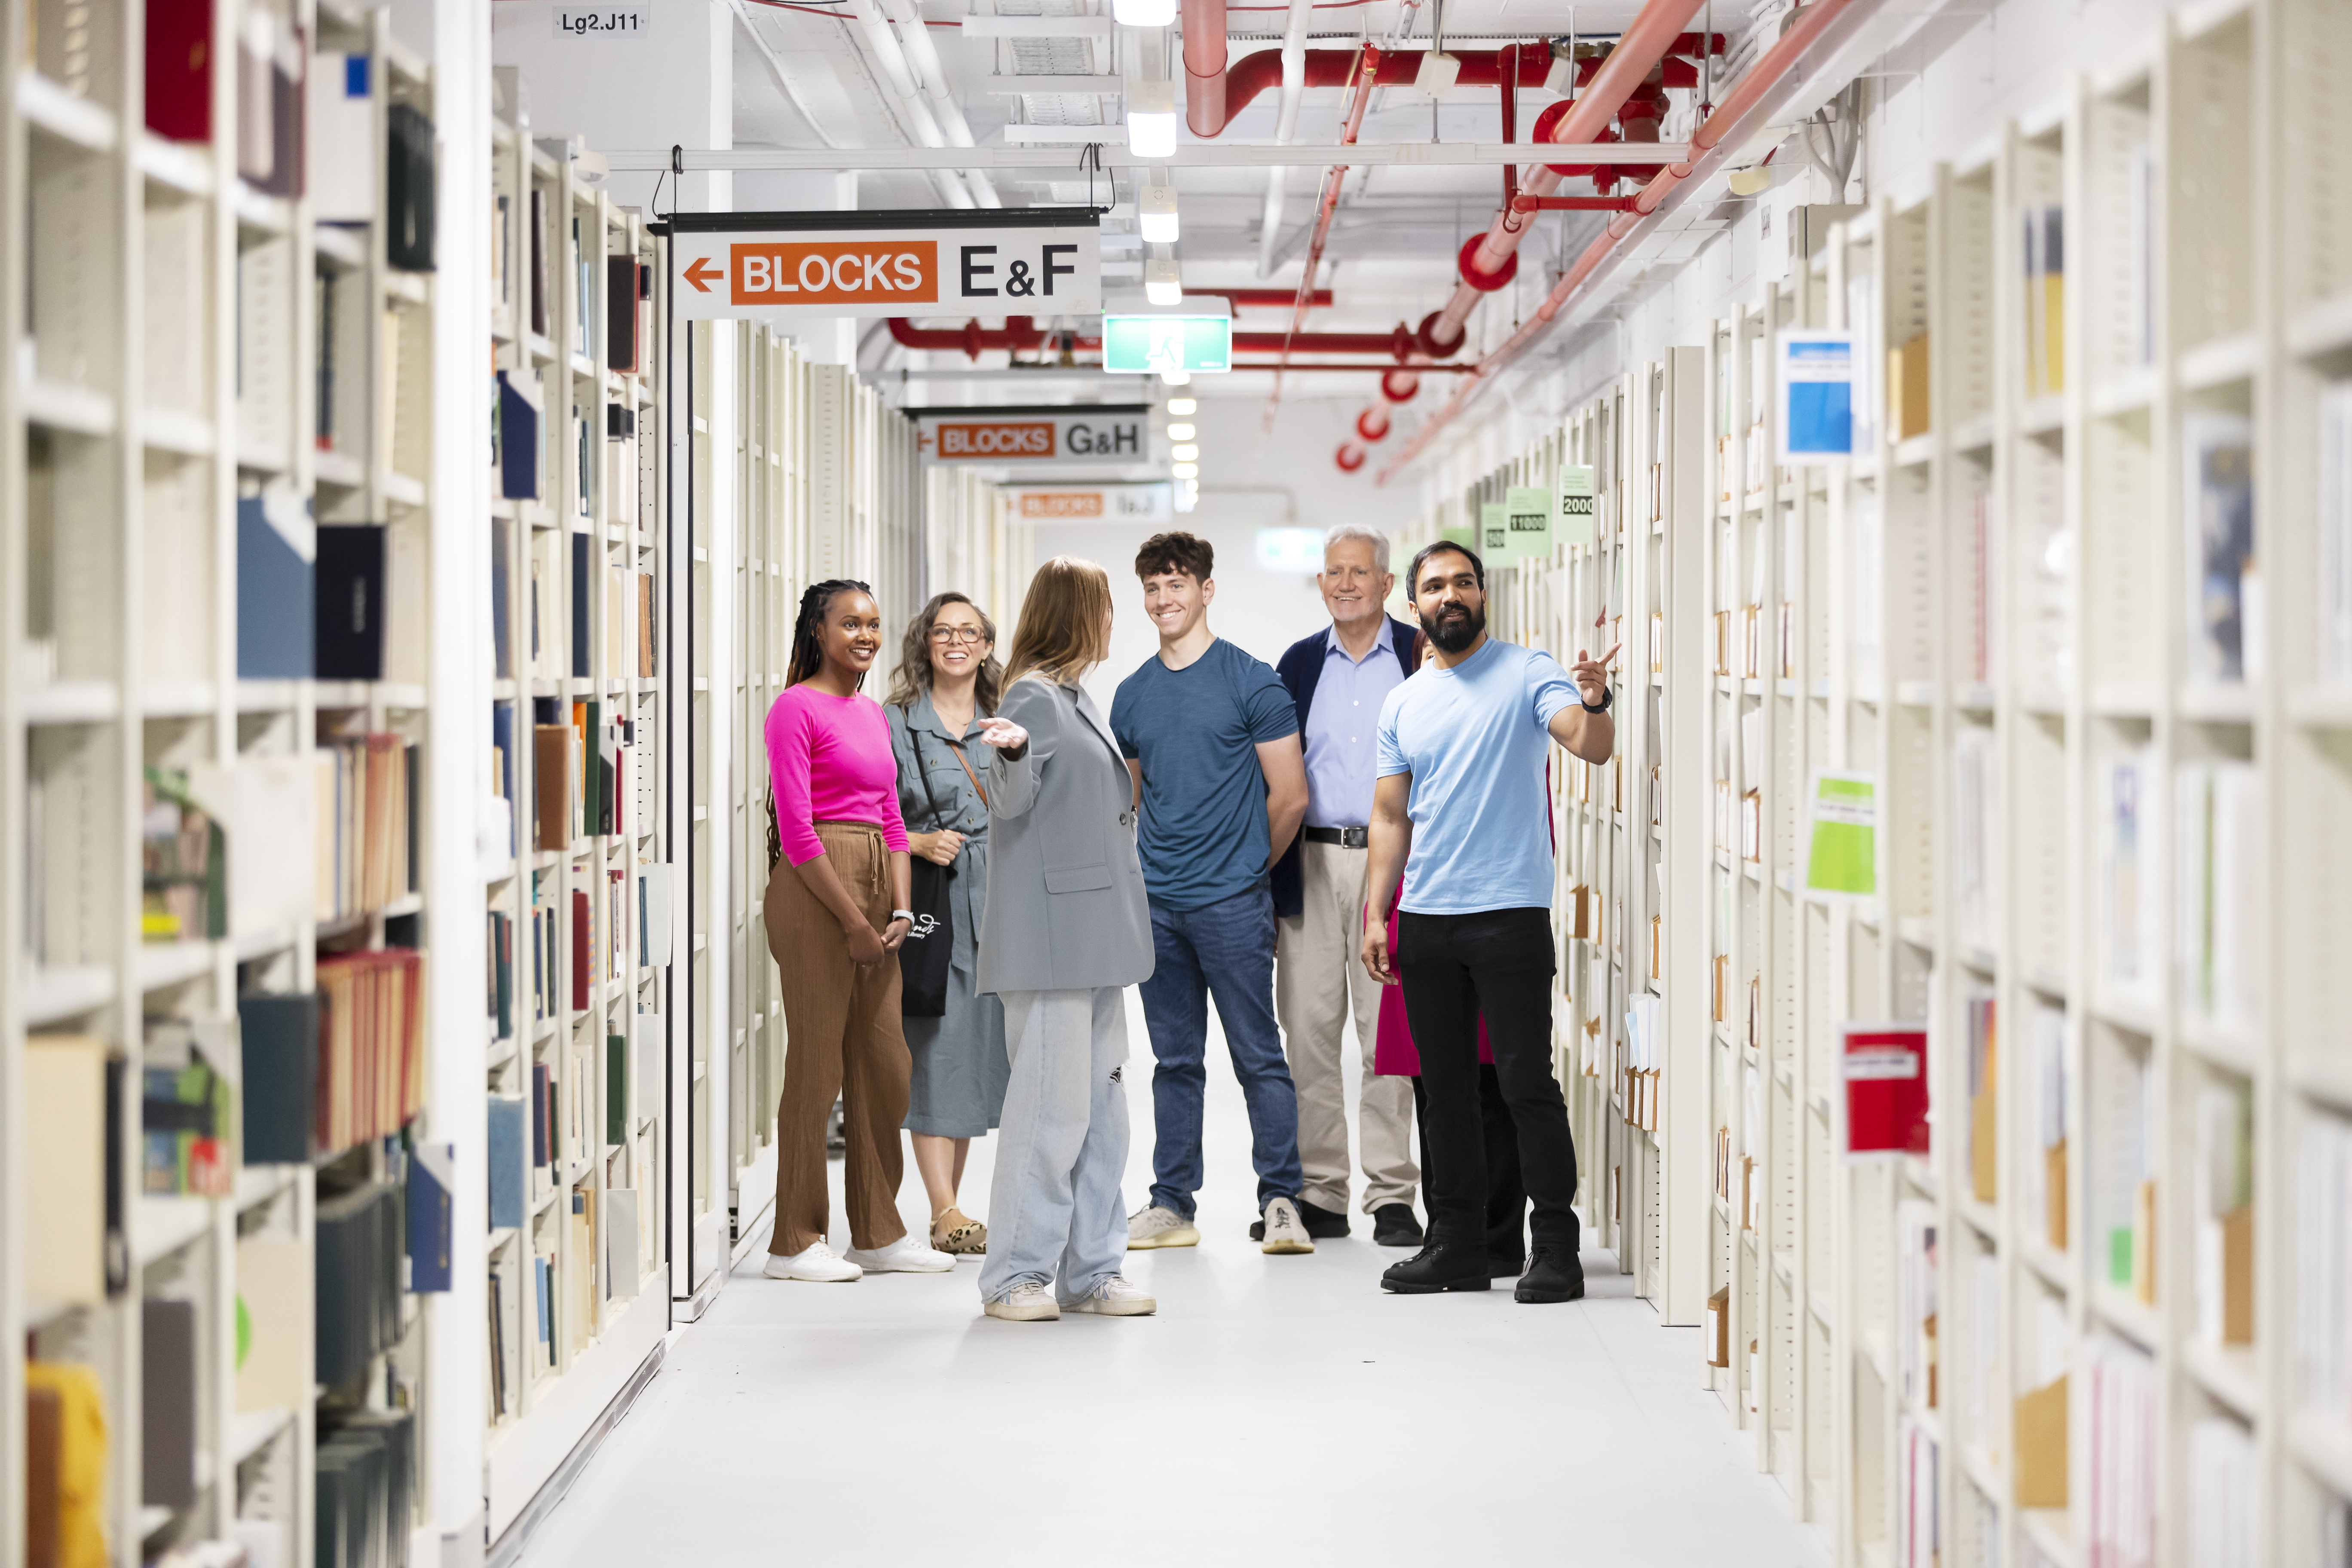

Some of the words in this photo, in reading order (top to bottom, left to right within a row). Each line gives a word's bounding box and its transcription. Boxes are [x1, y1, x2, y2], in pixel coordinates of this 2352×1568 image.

[563, 14, 637, 35] Lg2.J11
[743, 254, 922, 293] BLOCKS
[945, 427, 1050, 453] BLOCKS
[1066, 423, 1139, 455] G&H
